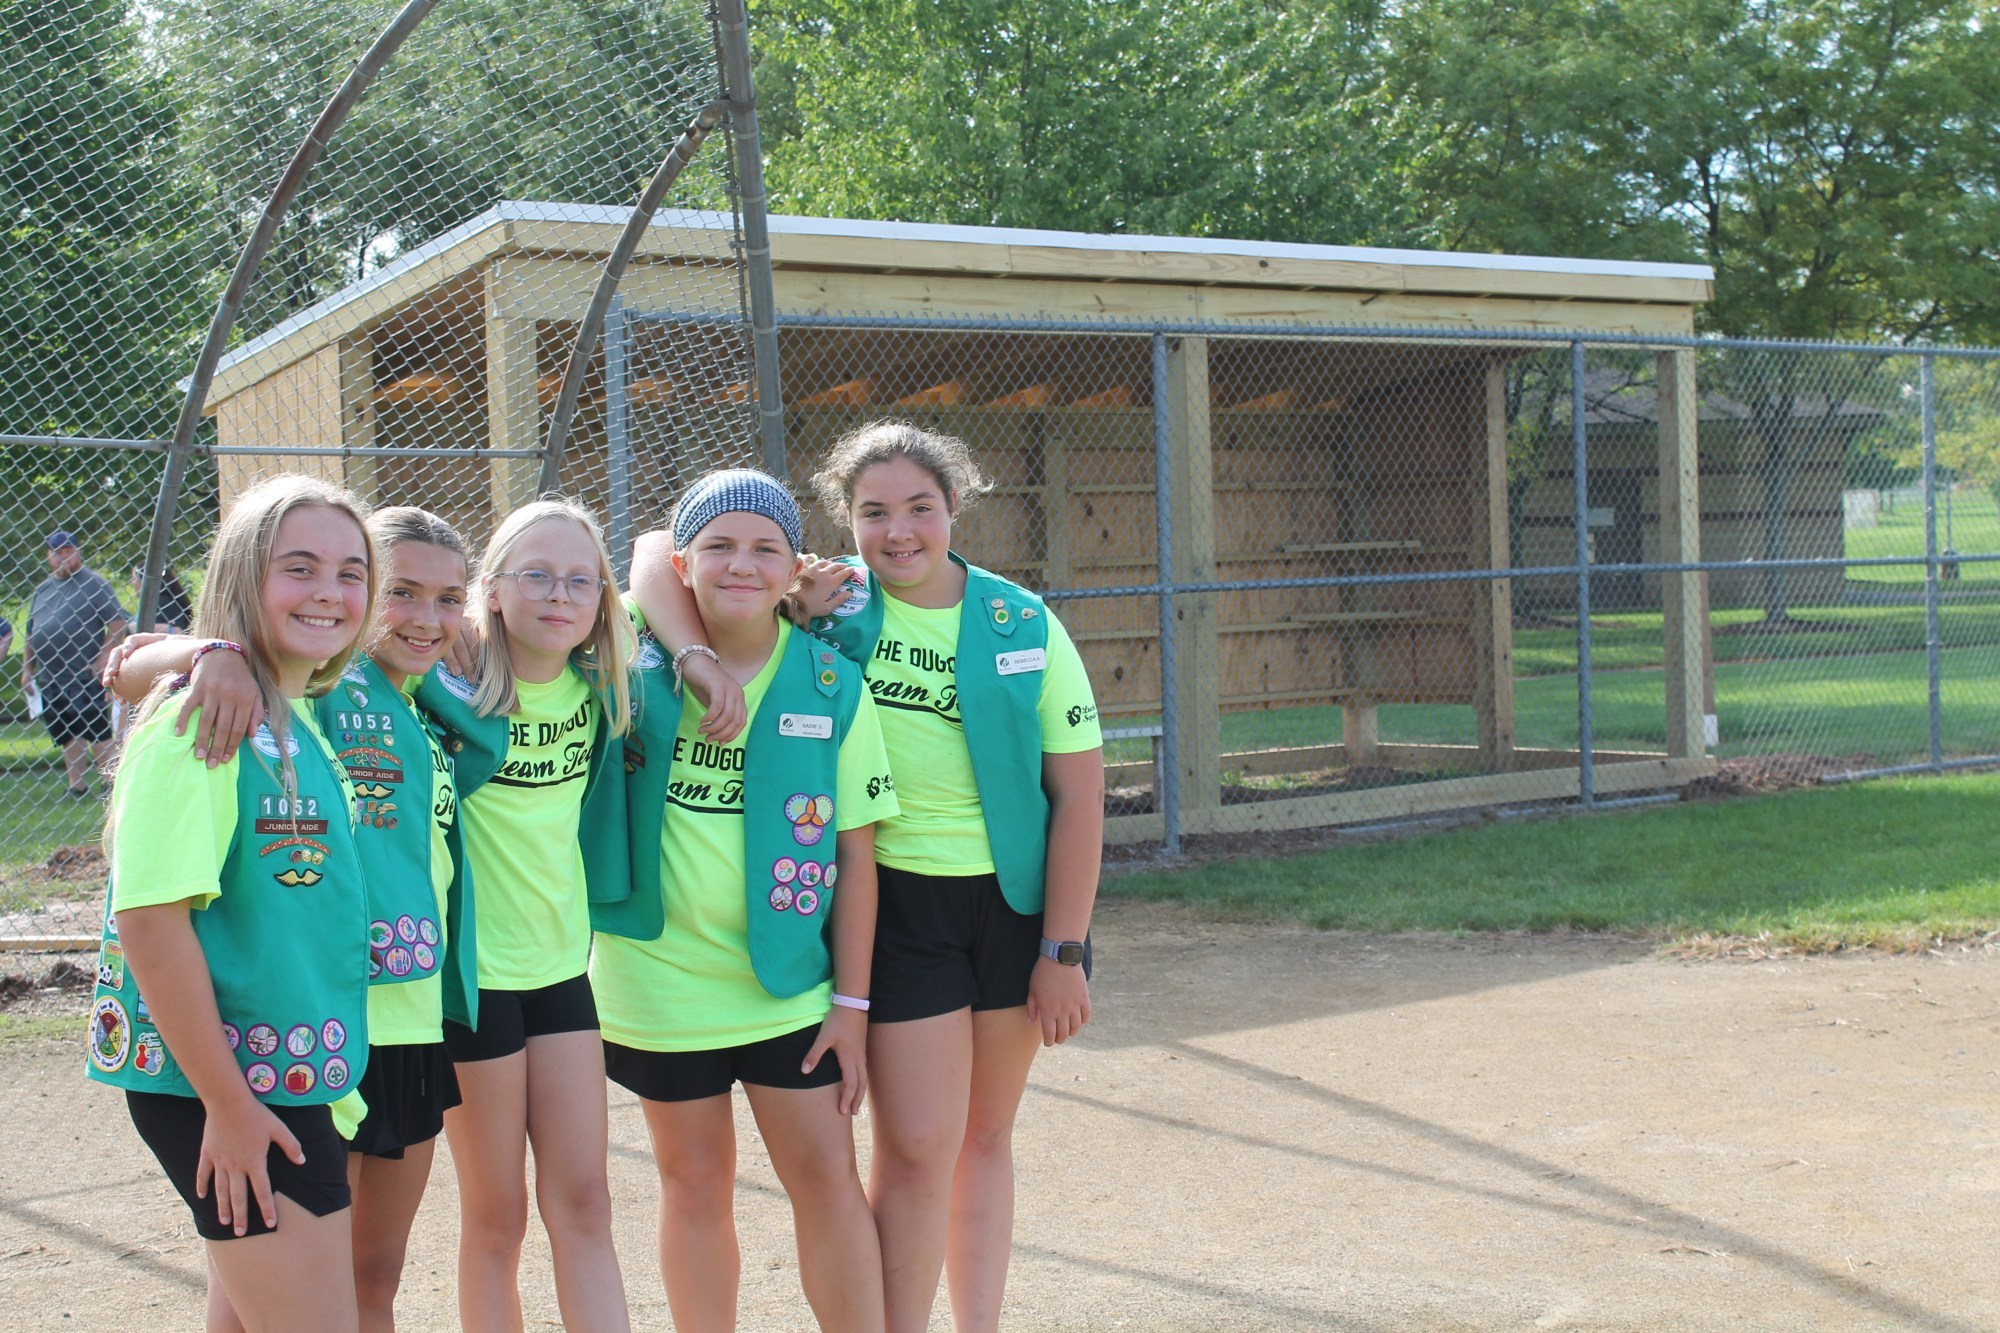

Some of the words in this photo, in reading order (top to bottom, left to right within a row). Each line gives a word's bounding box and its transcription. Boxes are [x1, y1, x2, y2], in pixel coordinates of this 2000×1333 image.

[875, 639, 904, 662] HE
[909, 647, 956, 673] DUGO
[863, 674, 930, 702] eam
[338, 713, 393, 731] 1052
[509, 723, 530, 747] HE
[690, 740, 746, 772] DUGO
[376, 771, 394, 780] AIDE
[497, 759, 557, 778] eam
[263, 797, 317, 816] 1052
[301, 823, 319, 831] AIDE
